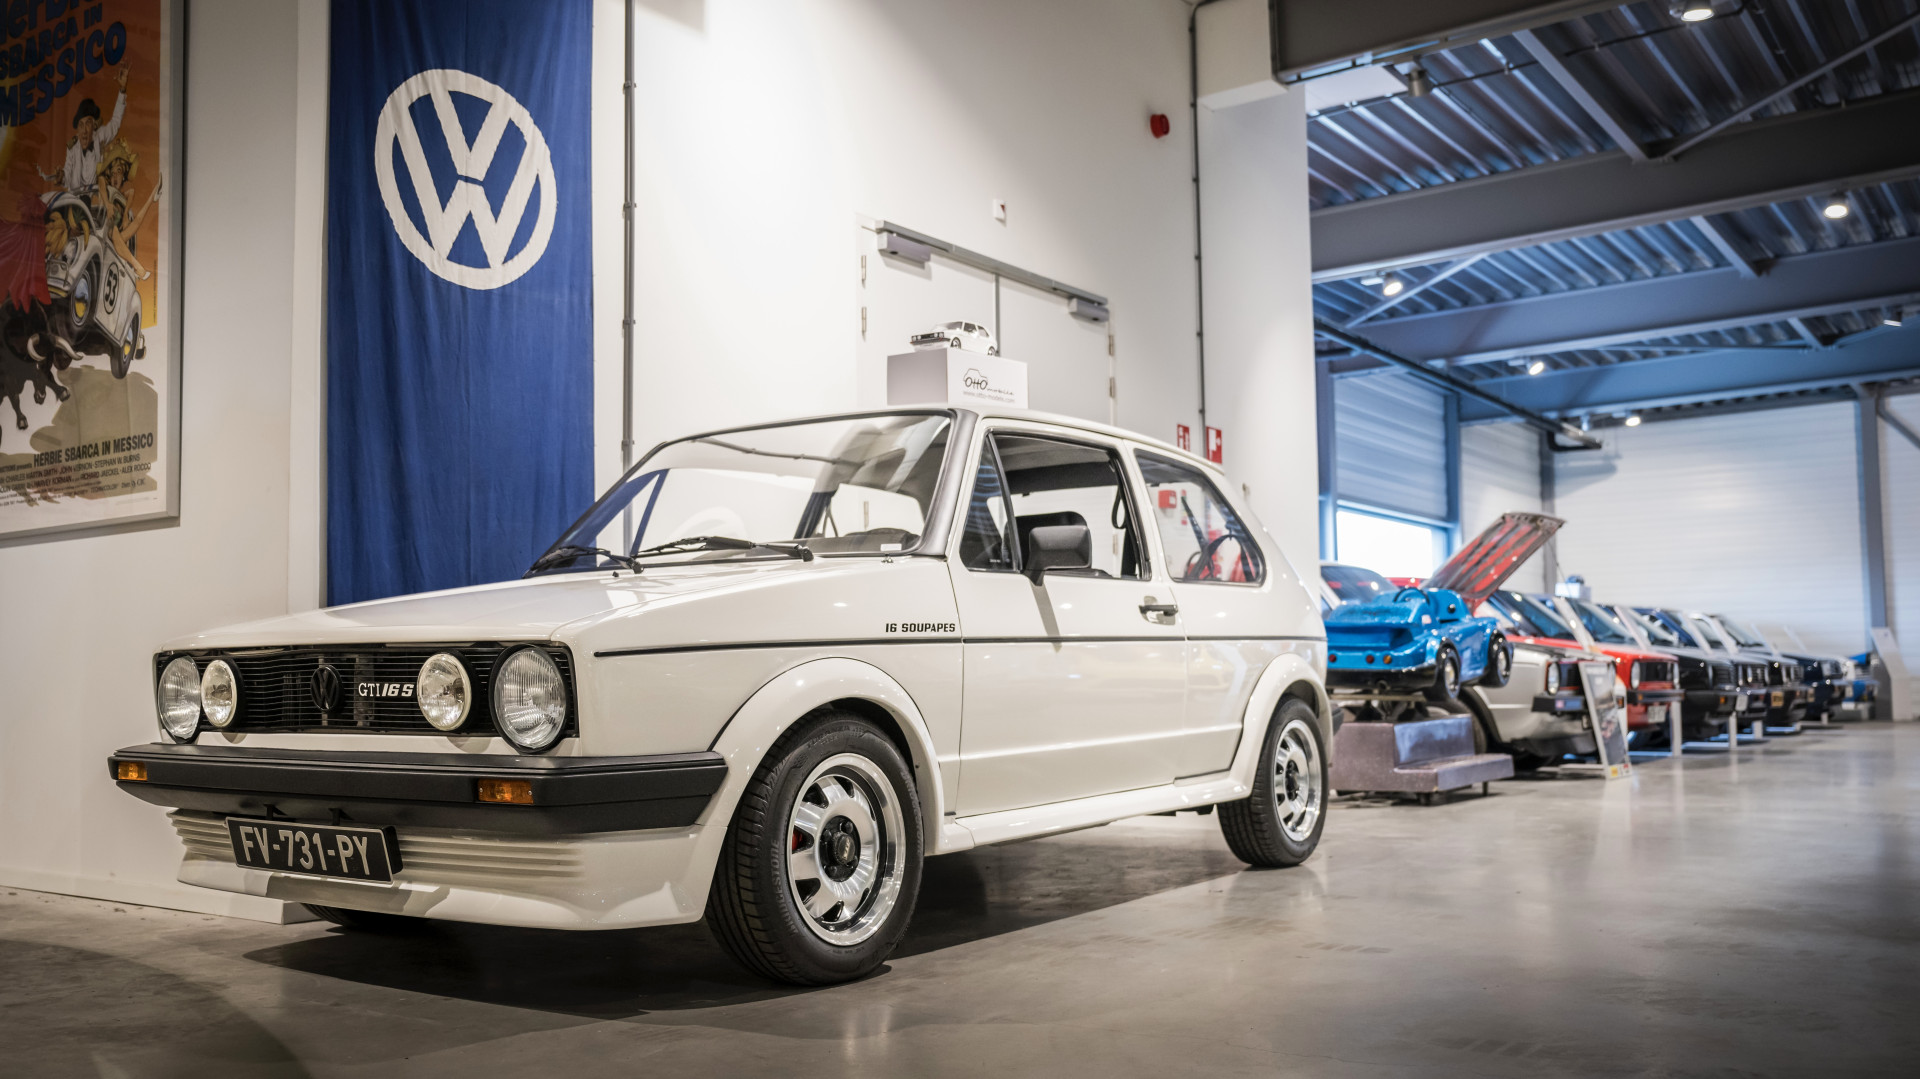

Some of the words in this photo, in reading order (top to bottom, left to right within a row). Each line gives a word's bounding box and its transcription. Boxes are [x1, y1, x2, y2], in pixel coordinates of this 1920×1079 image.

[84, 3, 102, 30] IN
[34, 450, 62, 467] HERBIE
[65, 443, 99, 462] SBARCA
[102, 440, 111, 455] IN
[113, 432, 153, 453] MESSICO
[885, 622, 898, 633] 16
[901, 622, 956, 633] SOUPAPES
[239, 825, 370, 876] FV-731-PY
